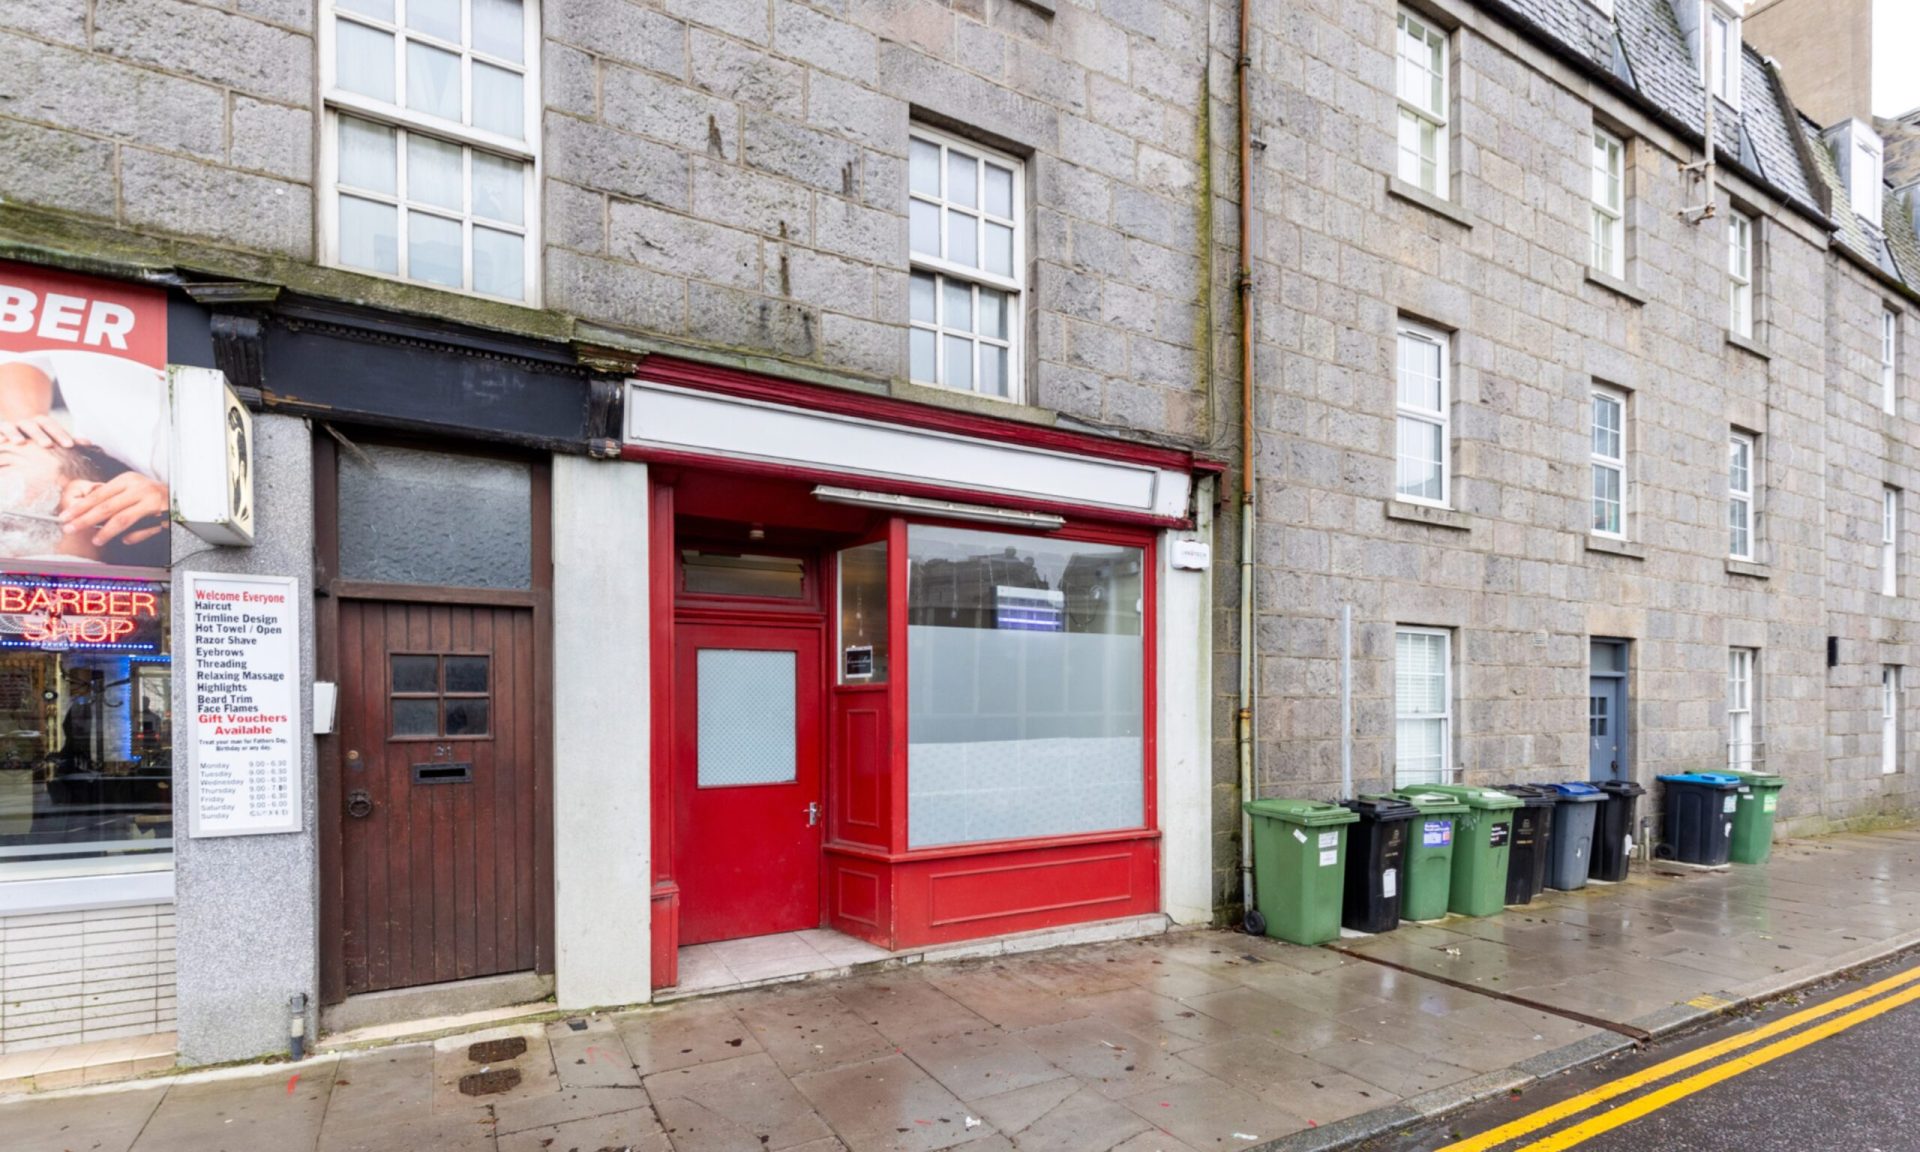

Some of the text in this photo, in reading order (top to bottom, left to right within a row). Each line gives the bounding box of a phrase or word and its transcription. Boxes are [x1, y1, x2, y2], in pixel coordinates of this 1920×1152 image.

[0, 284, 135, 350] BER
[0, 585, 156, 616] BARBER
[196, 590, 284, 604] Welcome Everyone
[194, 601, 232, 611] Haircut
[196, 613, 278, 625] Trimline Design
[23, 618, 135, 643] SHOP
[195, 624, 213, 633] Hot
[216, 624, 246, 633] Towel
[256, 625, 282, 635] Open
[196, 636, 257, 645] Razor Shave
[196, 648, 244, 658] Eyebrows
[196, 660, 247, 670] Threading
[197, 672, 284, 682] Relaxing Massage
[197, 683, 247, 694] Highlights
[197, 695, 253, 704] Beard Trim
[198, 704, 258, 713] Face Flames
[198, 714, 288, 723] Gift Vouchers
[215, 726, 272, 735] Available
[200, 762, 230, 770] Monday
